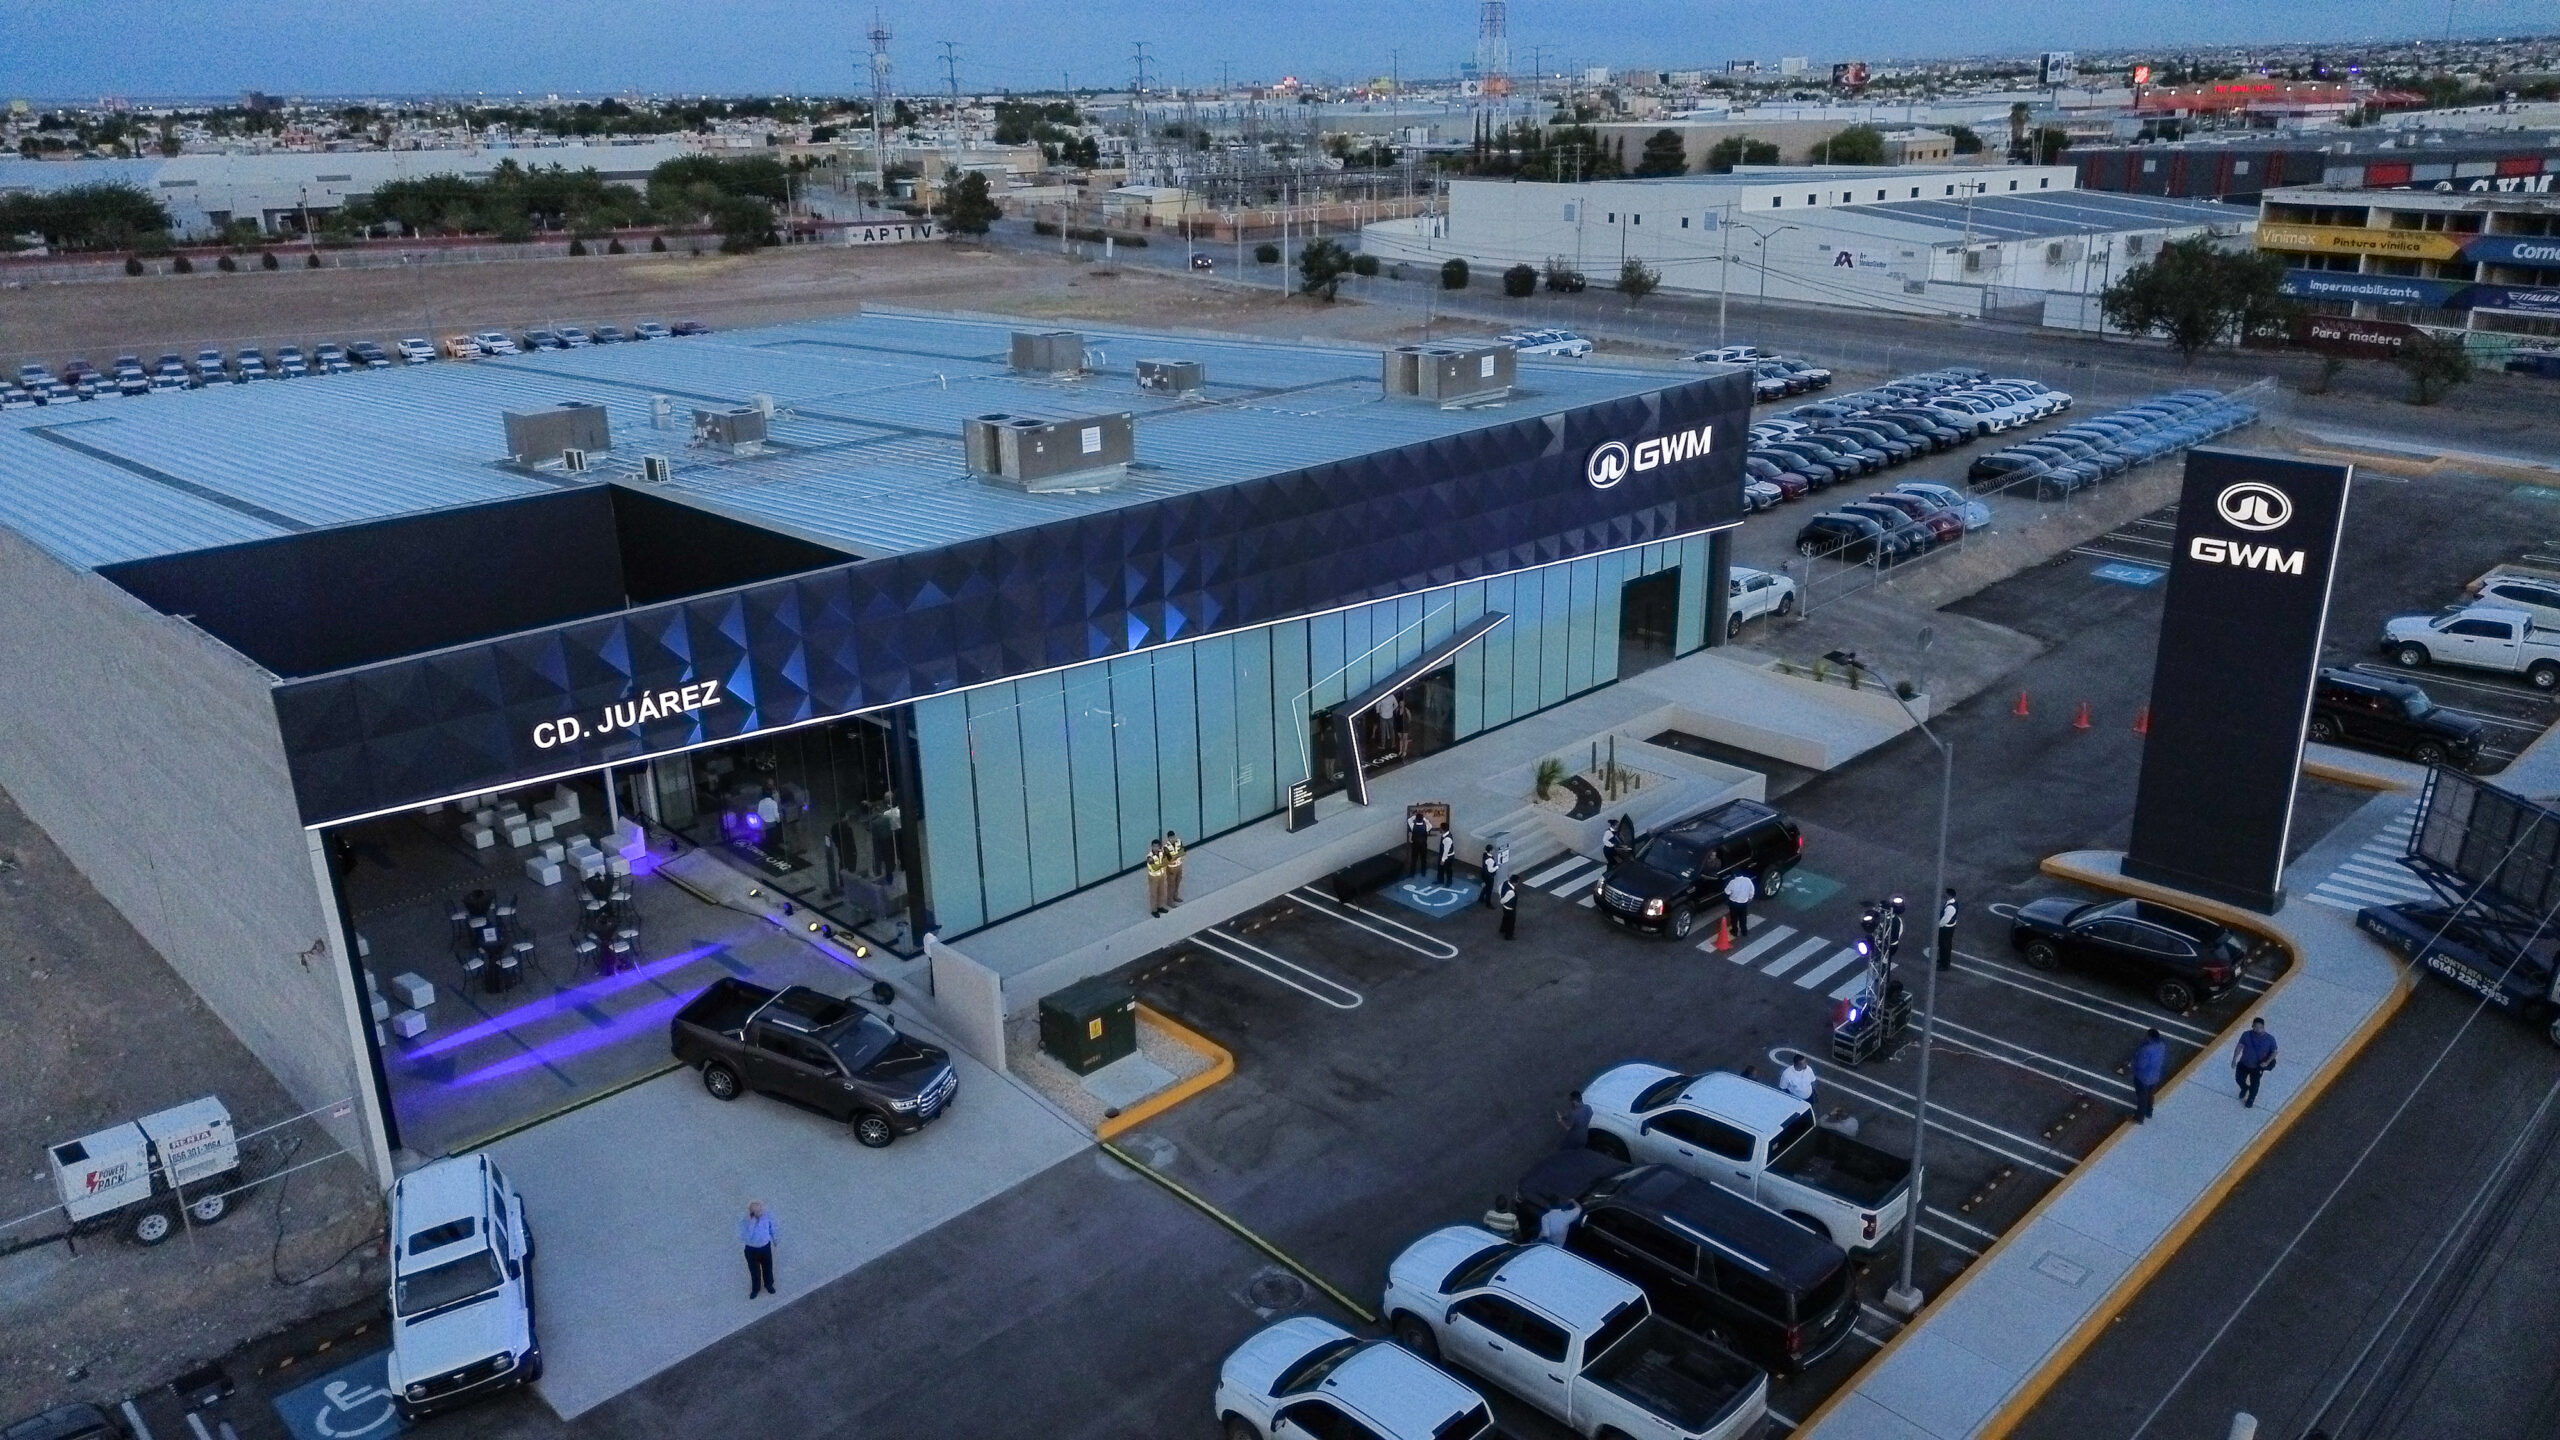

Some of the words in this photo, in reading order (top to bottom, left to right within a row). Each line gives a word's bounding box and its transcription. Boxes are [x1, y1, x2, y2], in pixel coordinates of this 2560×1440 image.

[863, 225, 932, 242] APTIV
[2262, 228, 2317, 246] Vinimex
[2333, 236, 2377, 249] Pintura
[2311, 326, 2342, 340] Para
[2348, 331, 2403, 346] madera
[1633, 425, 1713, 472] GWM
[2190, 536, 2305, 575] GWM
[533, 716, 591, 749] CD.
[597, 679, 721, 733] JUÁREZ
[2427, 956, 2457, 978] (614)
[98, 1165, 126, 1180] POWER
[98, 1174, 126, 1191] PACK
